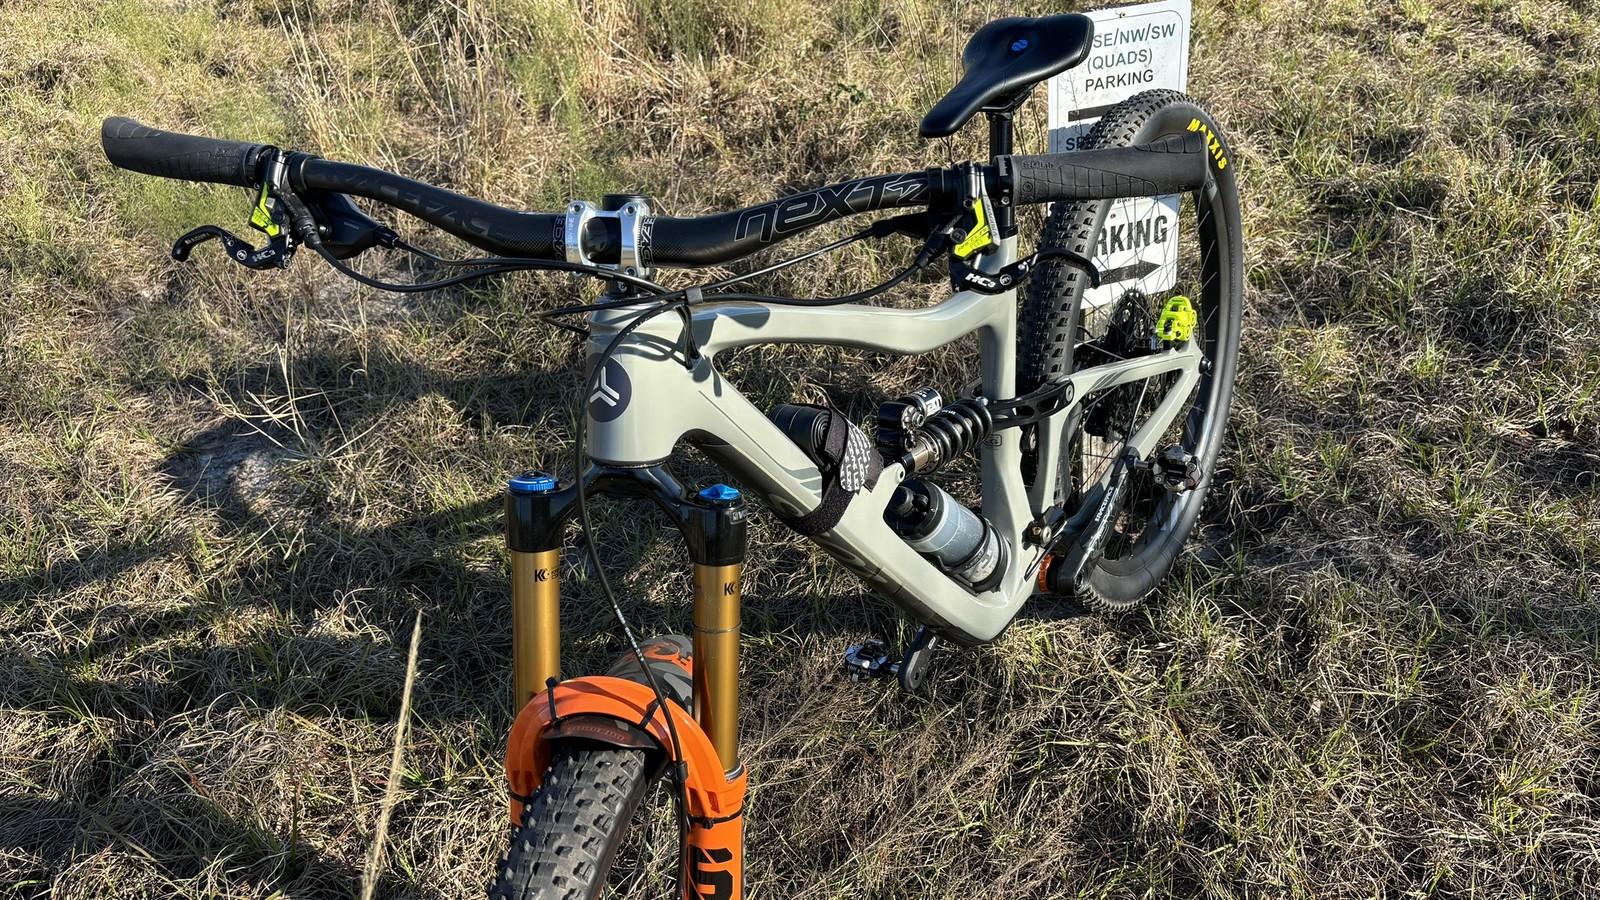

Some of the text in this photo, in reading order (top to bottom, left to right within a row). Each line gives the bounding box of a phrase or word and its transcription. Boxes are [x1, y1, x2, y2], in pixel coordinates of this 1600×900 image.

[1087, 48, 1153, 73] (QUADS)
[1085, 69, 1154, 92] PARKING
[1187, 118, 1227, 169] MAXXIS
[252, 249, 276, 262] HC3
[965, 273, 996, 288] HC3
